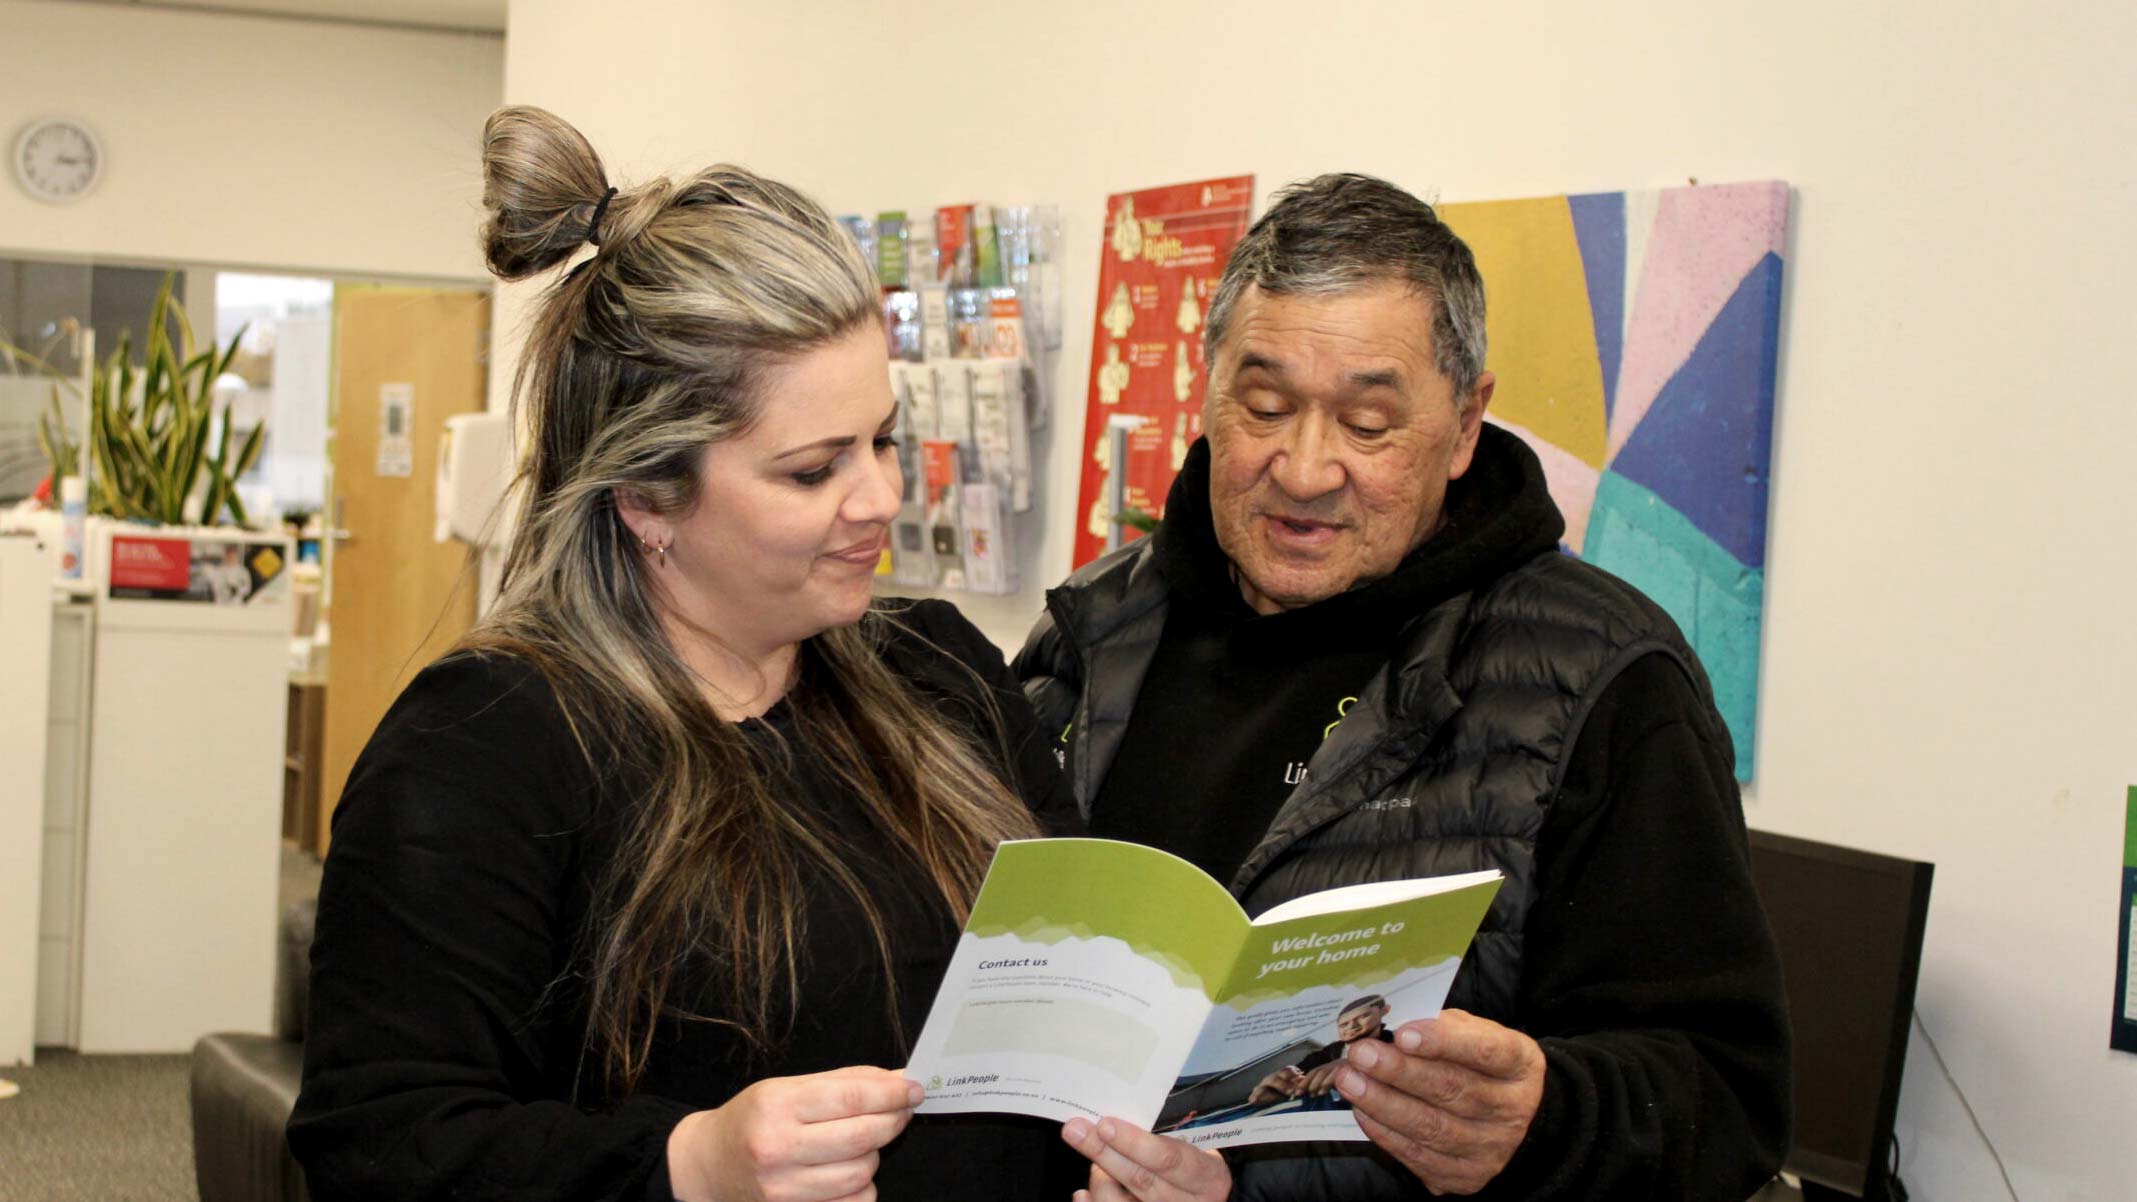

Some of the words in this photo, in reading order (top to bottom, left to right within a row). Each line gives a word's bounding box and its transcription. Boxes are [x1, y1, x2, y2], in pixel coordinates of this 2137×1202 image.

[1144, 237, 1183, 267] Rights
[1271, 926, 1377, 954] Welcome
[1380, 921, 1406, 935] to
[978, 958, 1030, 970] Contact
[1033, 958, 1048, 967] us
[1255, 955, 1314, 979] your
[1316, 943, 1381, 965] home
[946, 1073, 1000, 1088] LinkPeople
[1191, 1128, 1244, 1144] LinkPeople
